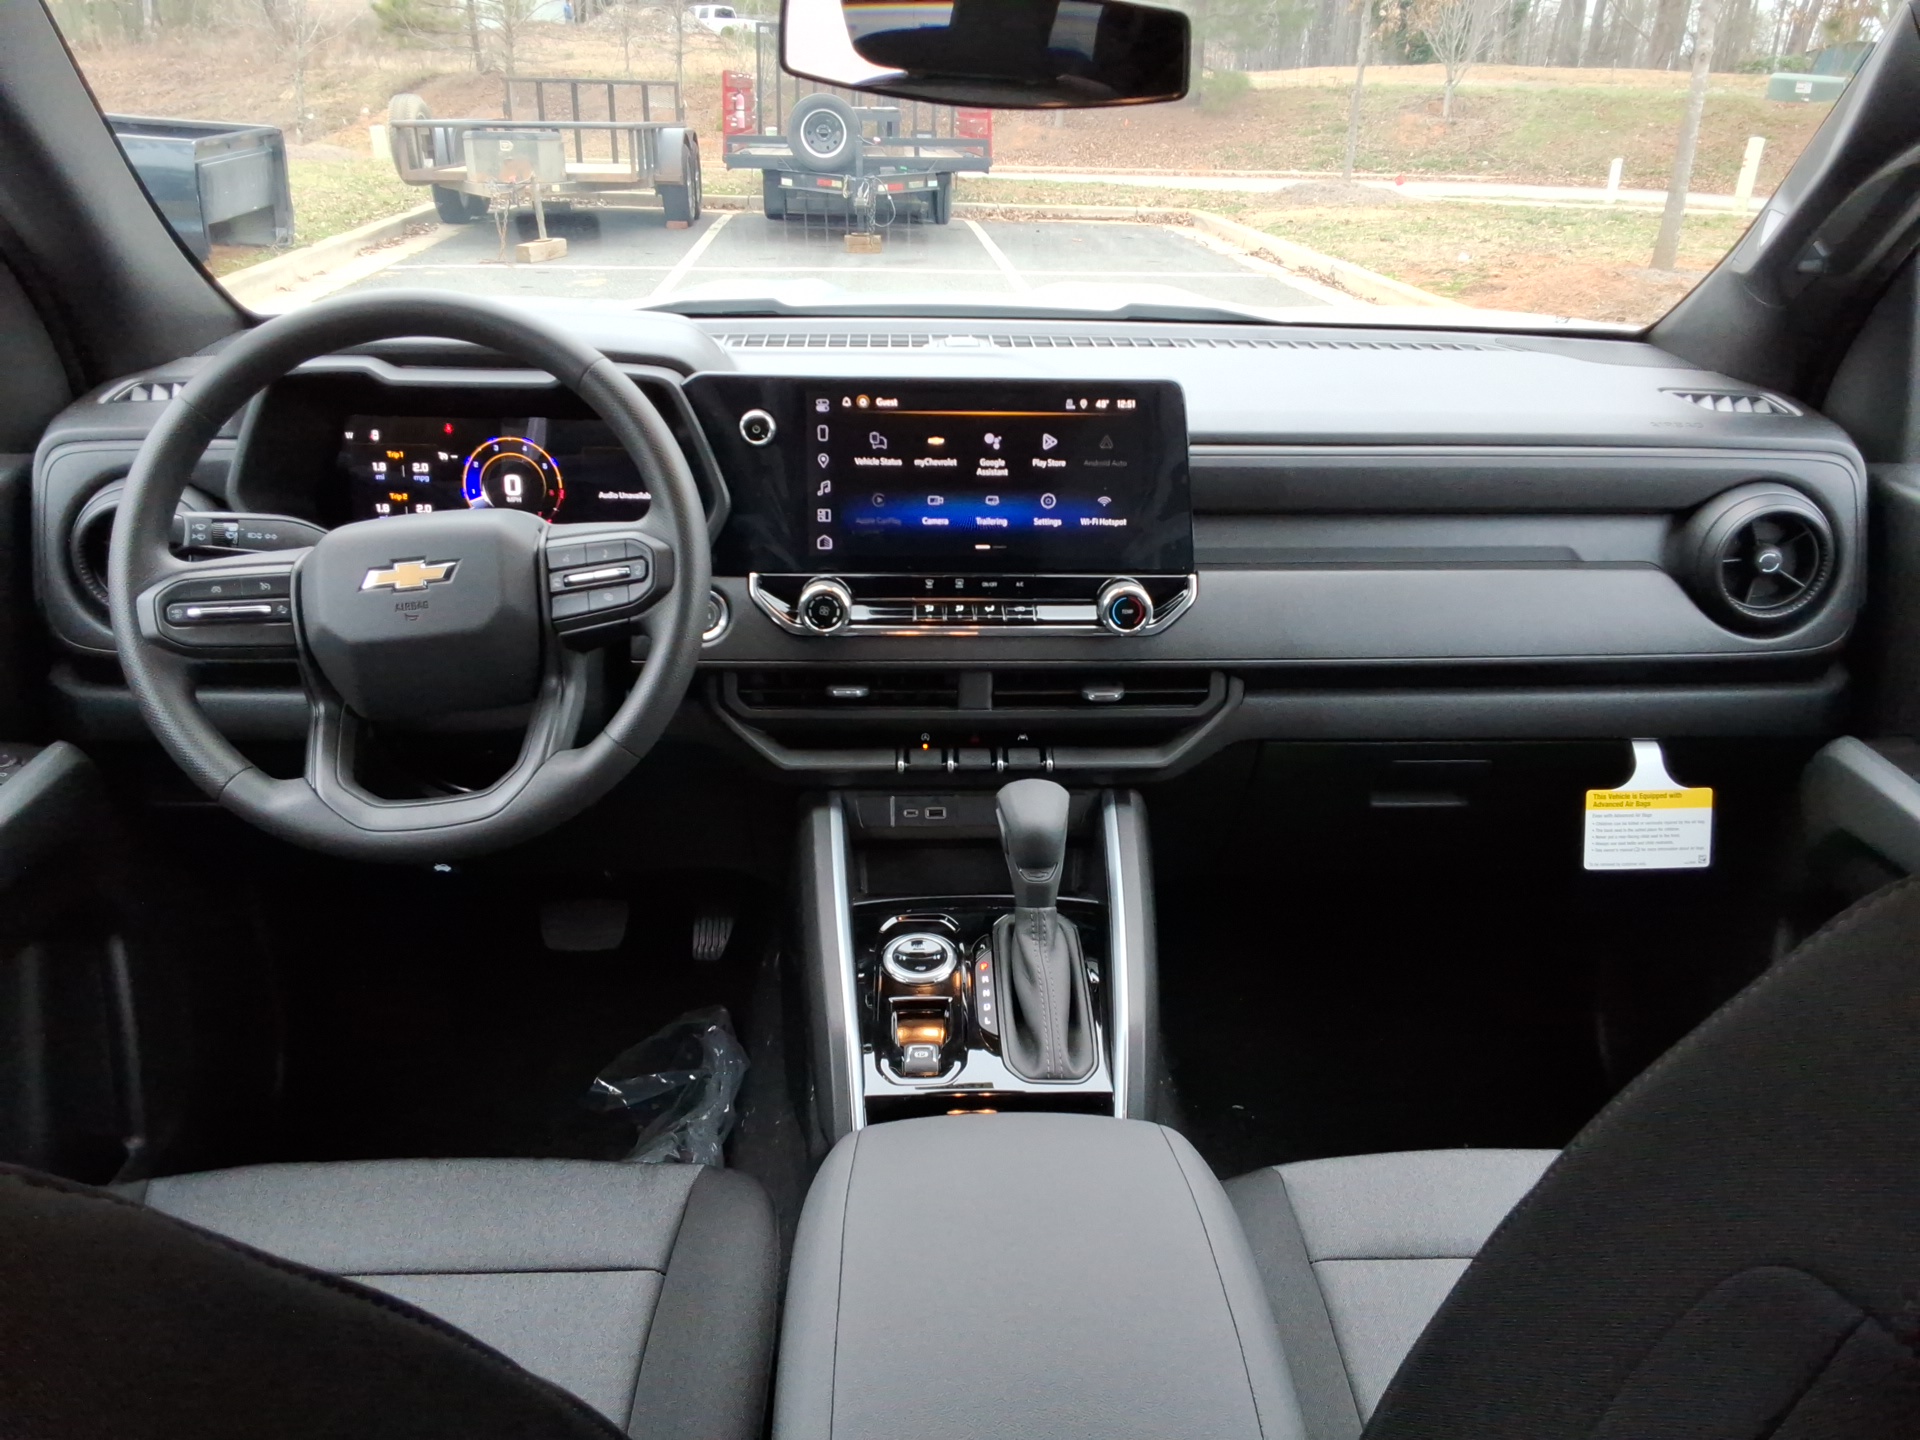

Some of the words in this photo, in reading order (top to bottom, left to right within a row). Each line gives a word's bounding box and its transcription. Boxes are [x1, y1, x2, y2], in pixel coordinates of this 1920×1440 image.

[386, 451, 400, 459] Trip
[854, 457, 880, 466] Vehicle
[880, 457, 902, 466] Status
[913, 457, 958, 468] myChevrolet
[979, 458, 1005, 468] Google
[1032, 458, 1047, 468] Play
[1047, 458, 1067, 467] Store
[1083, 459, 1110, 467] Android
[1111, 459, 1128, 467] Auto
[372, 462, 387, 472] 1.8
[412, 462, 429, 472] 2.0
[976, 468, 1009, 476] Assistant
[503, 473, 522, 496] 0
[389, 492, 402, 501] Trip
[598, 491, 618, 499] Audio
[375, 503, 390, 513] 1.8
[415, 504, 432, 513] 2.0
[921, 516, 950, 525] Camera
[1033, 517, 1062, 527] Settings
[1080, 517, 1098, 526] Wi-Fi
[1099, 518, 1127, 527] Hotspot
[395, 600, 429, 611] AIRBAG
[1639, 793, 1668, 801] Equipped
[980, 962, 988, 970] P
[983, 1003, 991, 1011] D
